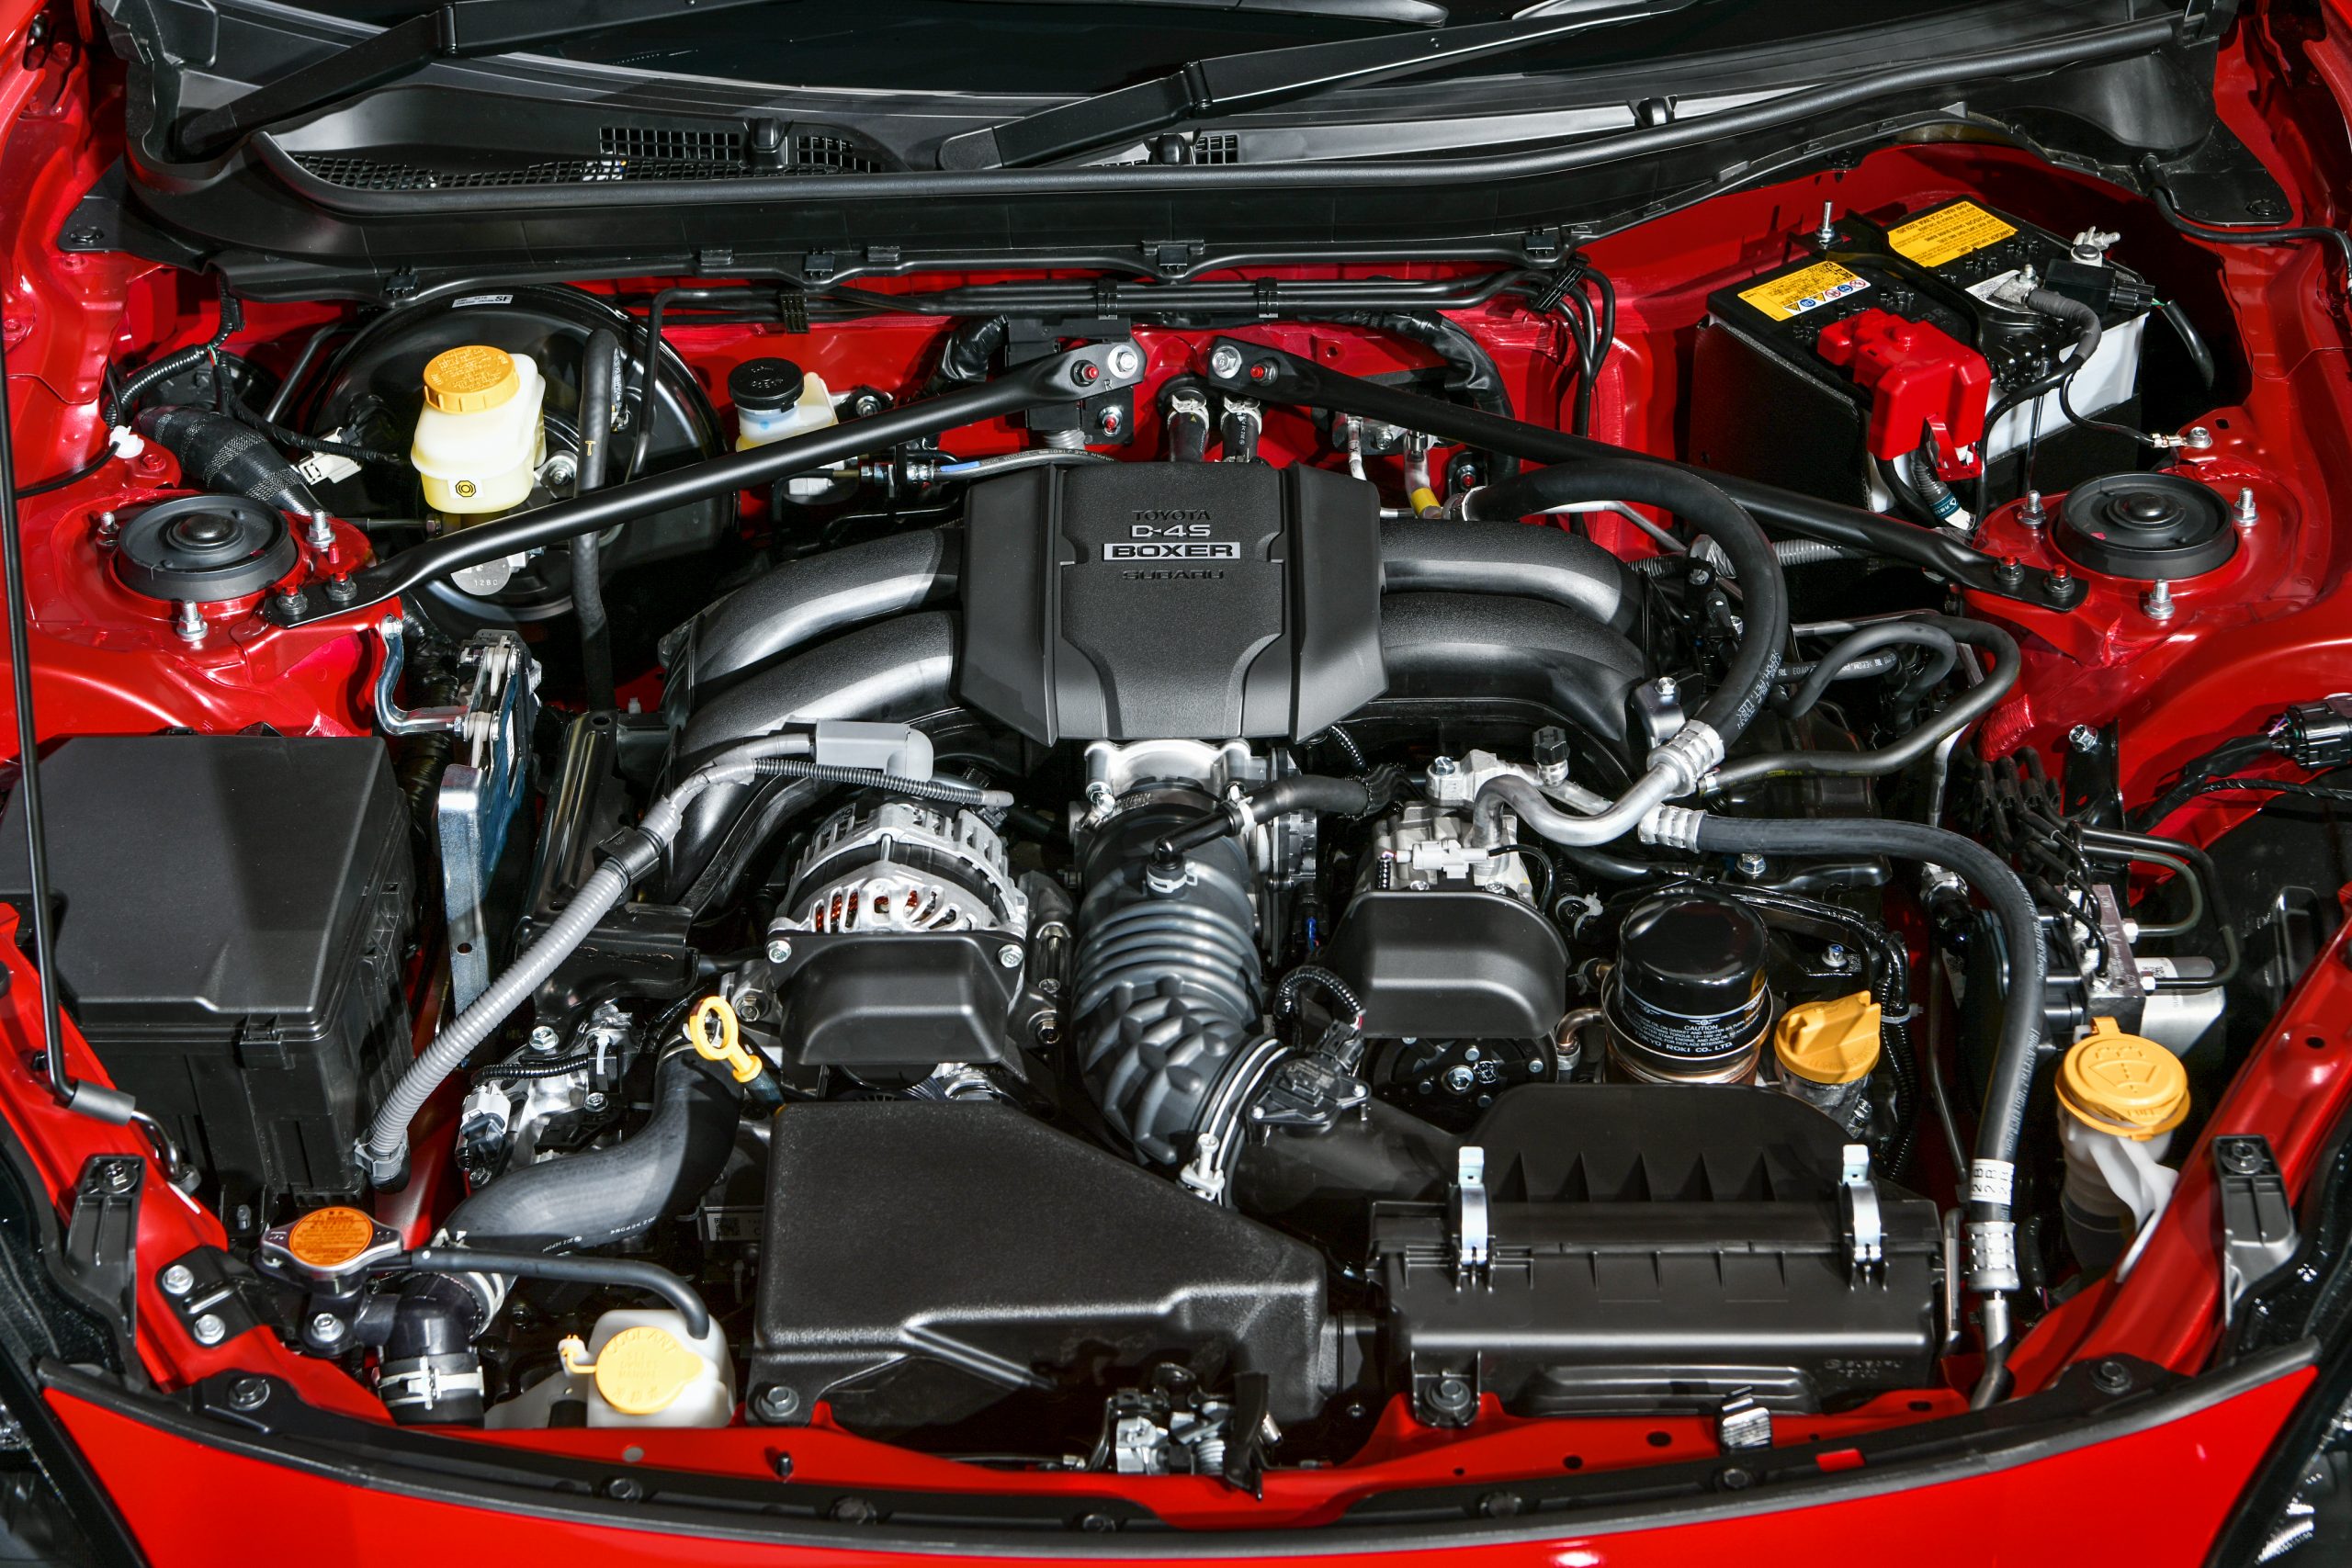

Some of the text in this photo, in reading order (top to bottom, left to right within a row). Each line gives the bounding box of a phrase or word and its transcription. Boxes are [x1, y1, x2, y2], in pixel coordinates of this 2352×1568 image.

[1103, 378, 1114, 391] R
[1131, 509, 1212, 522] TOYOTA
[1130, 524, 1212, 538] D-4S
[1112, 543, 1234, 559] BOXER
[1122, 570, 1225, 580] SUBARU
[1635, 1031, 1661, 1046] TOKYO
[1666, 1043, 1690, 1053] ROKI
[1657, 1032, 1674, 1040] START
[605, 1329, 677, 1354] COOLANT
